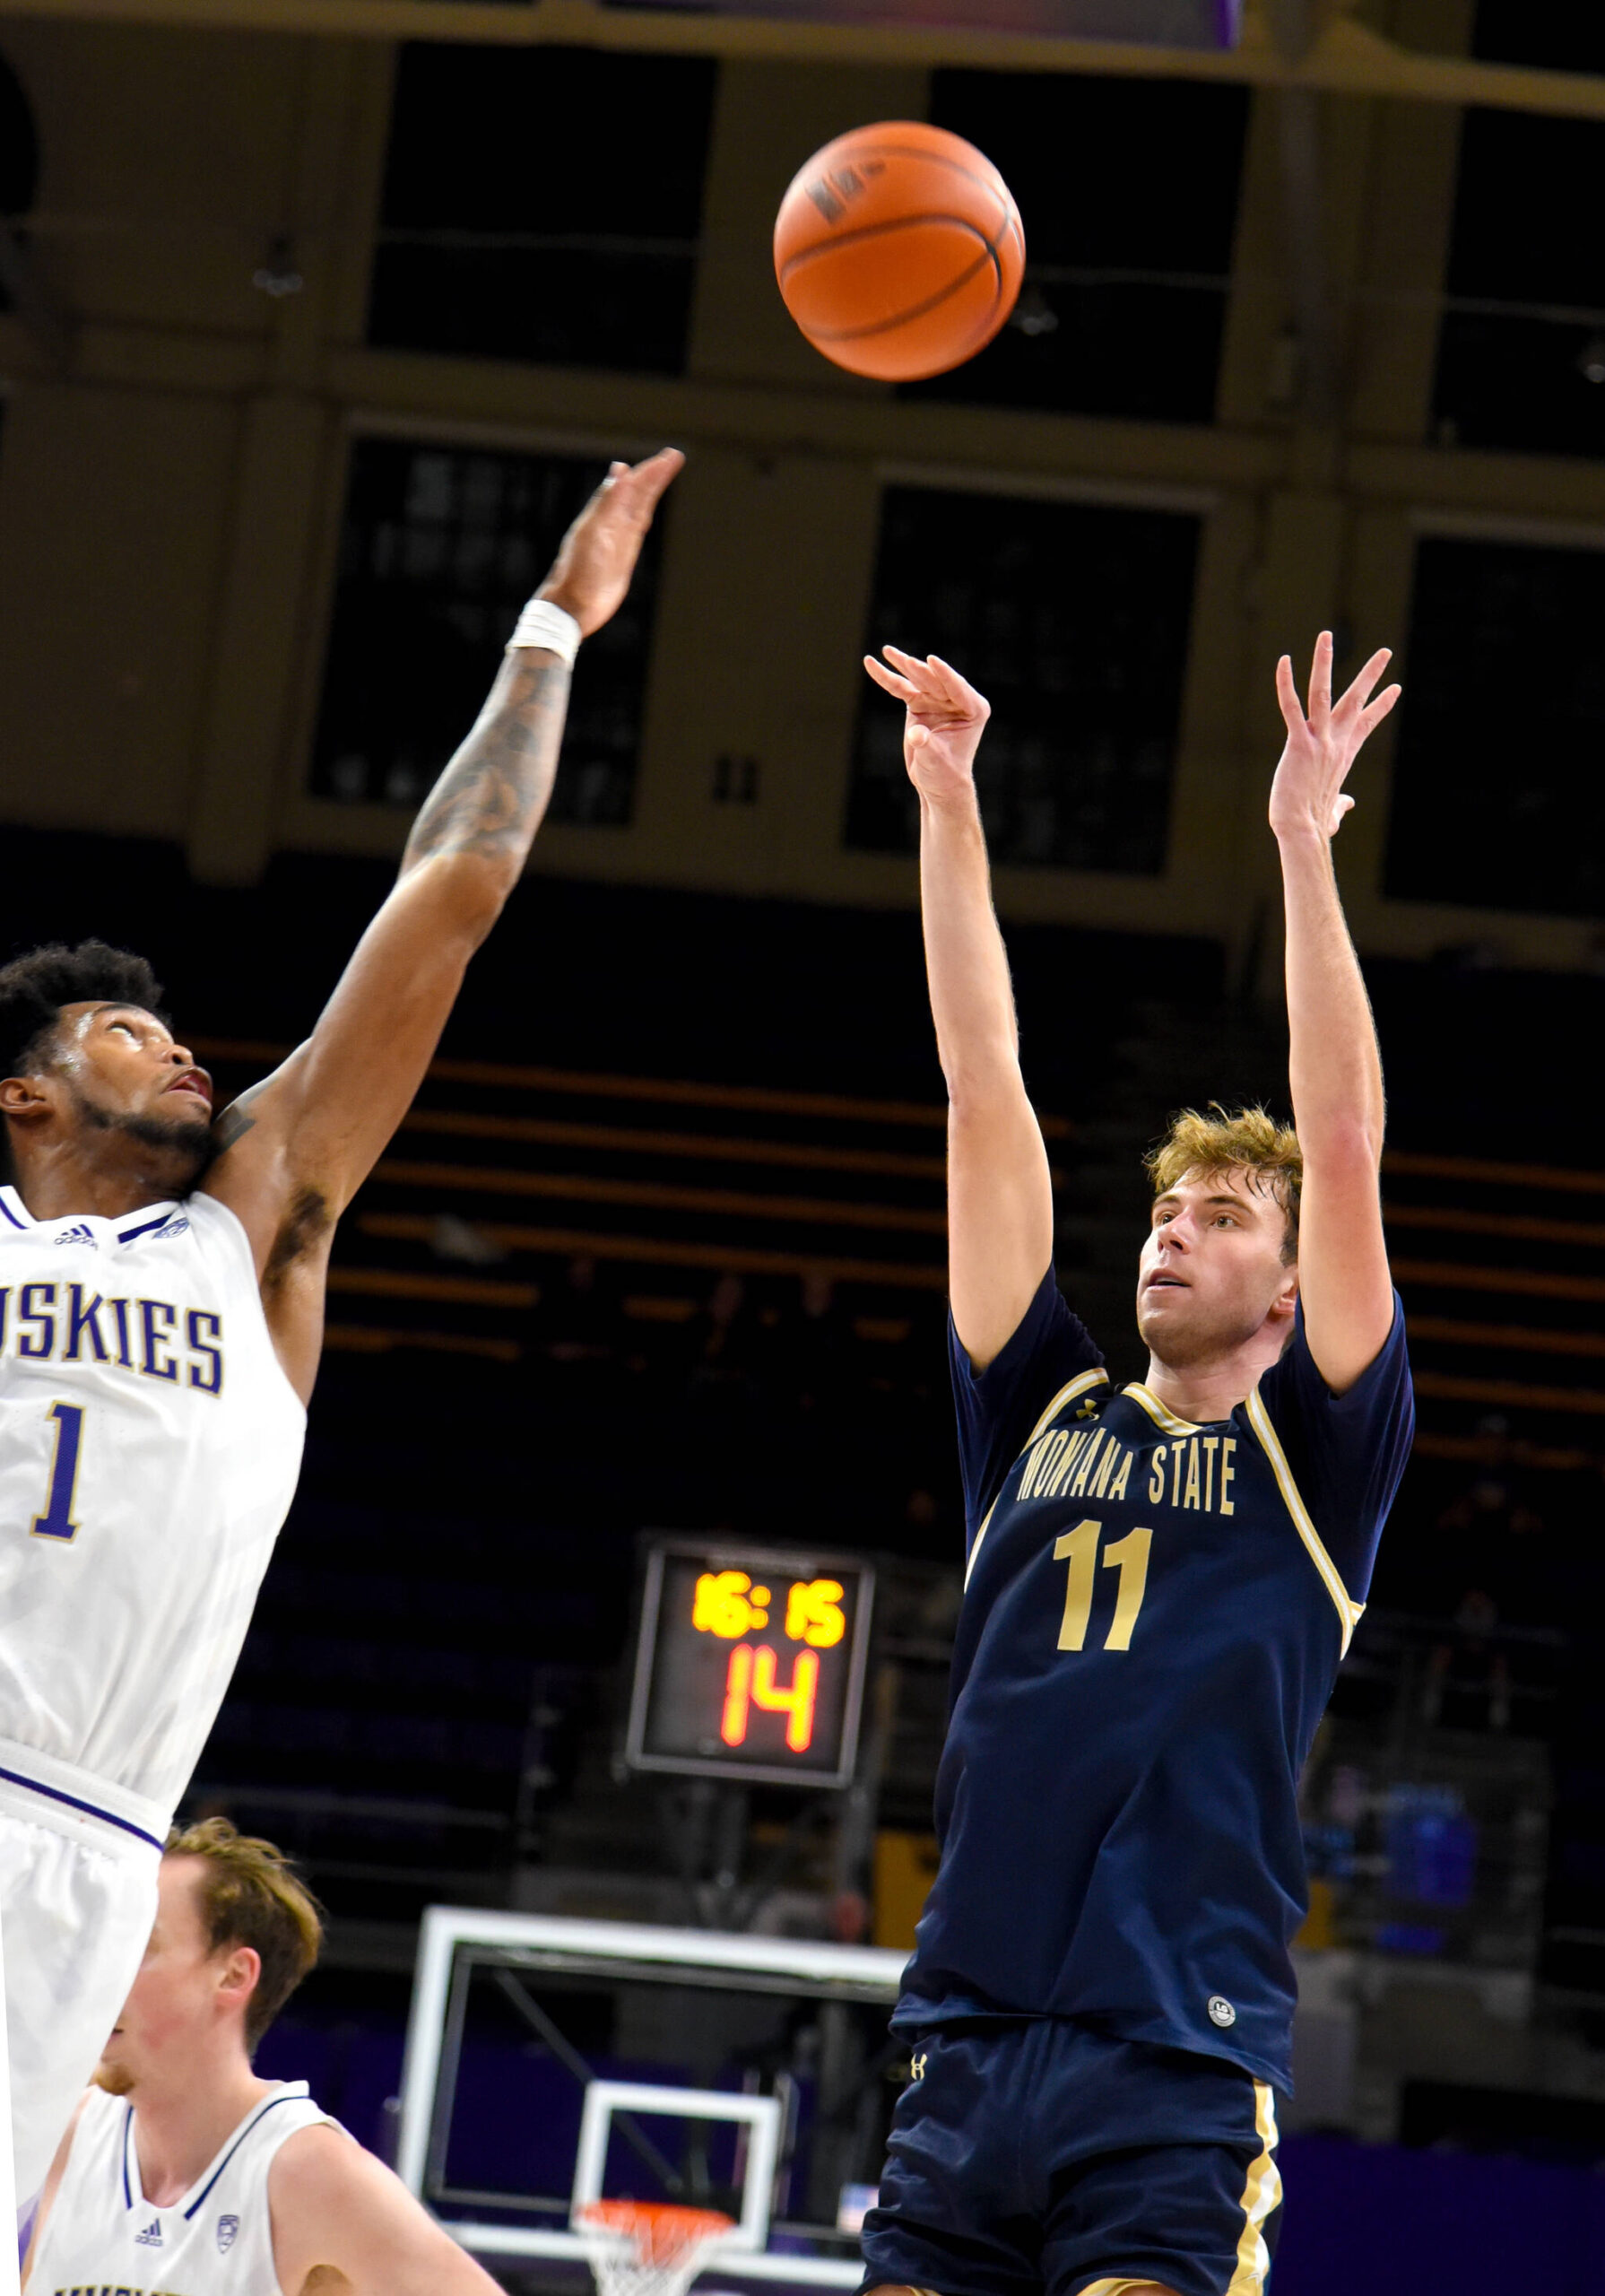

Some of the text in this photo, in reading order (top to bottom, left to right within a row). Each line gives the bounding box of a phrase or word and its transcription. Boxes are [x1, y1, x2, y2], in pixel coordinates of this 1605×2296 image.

[29, 1399, 85, 1543] 1
[1149, 1437, 1237, 1516] STATE
[1053, 1518, 1153, 1651] 11
[720, 1643, 820, 1752] 14
